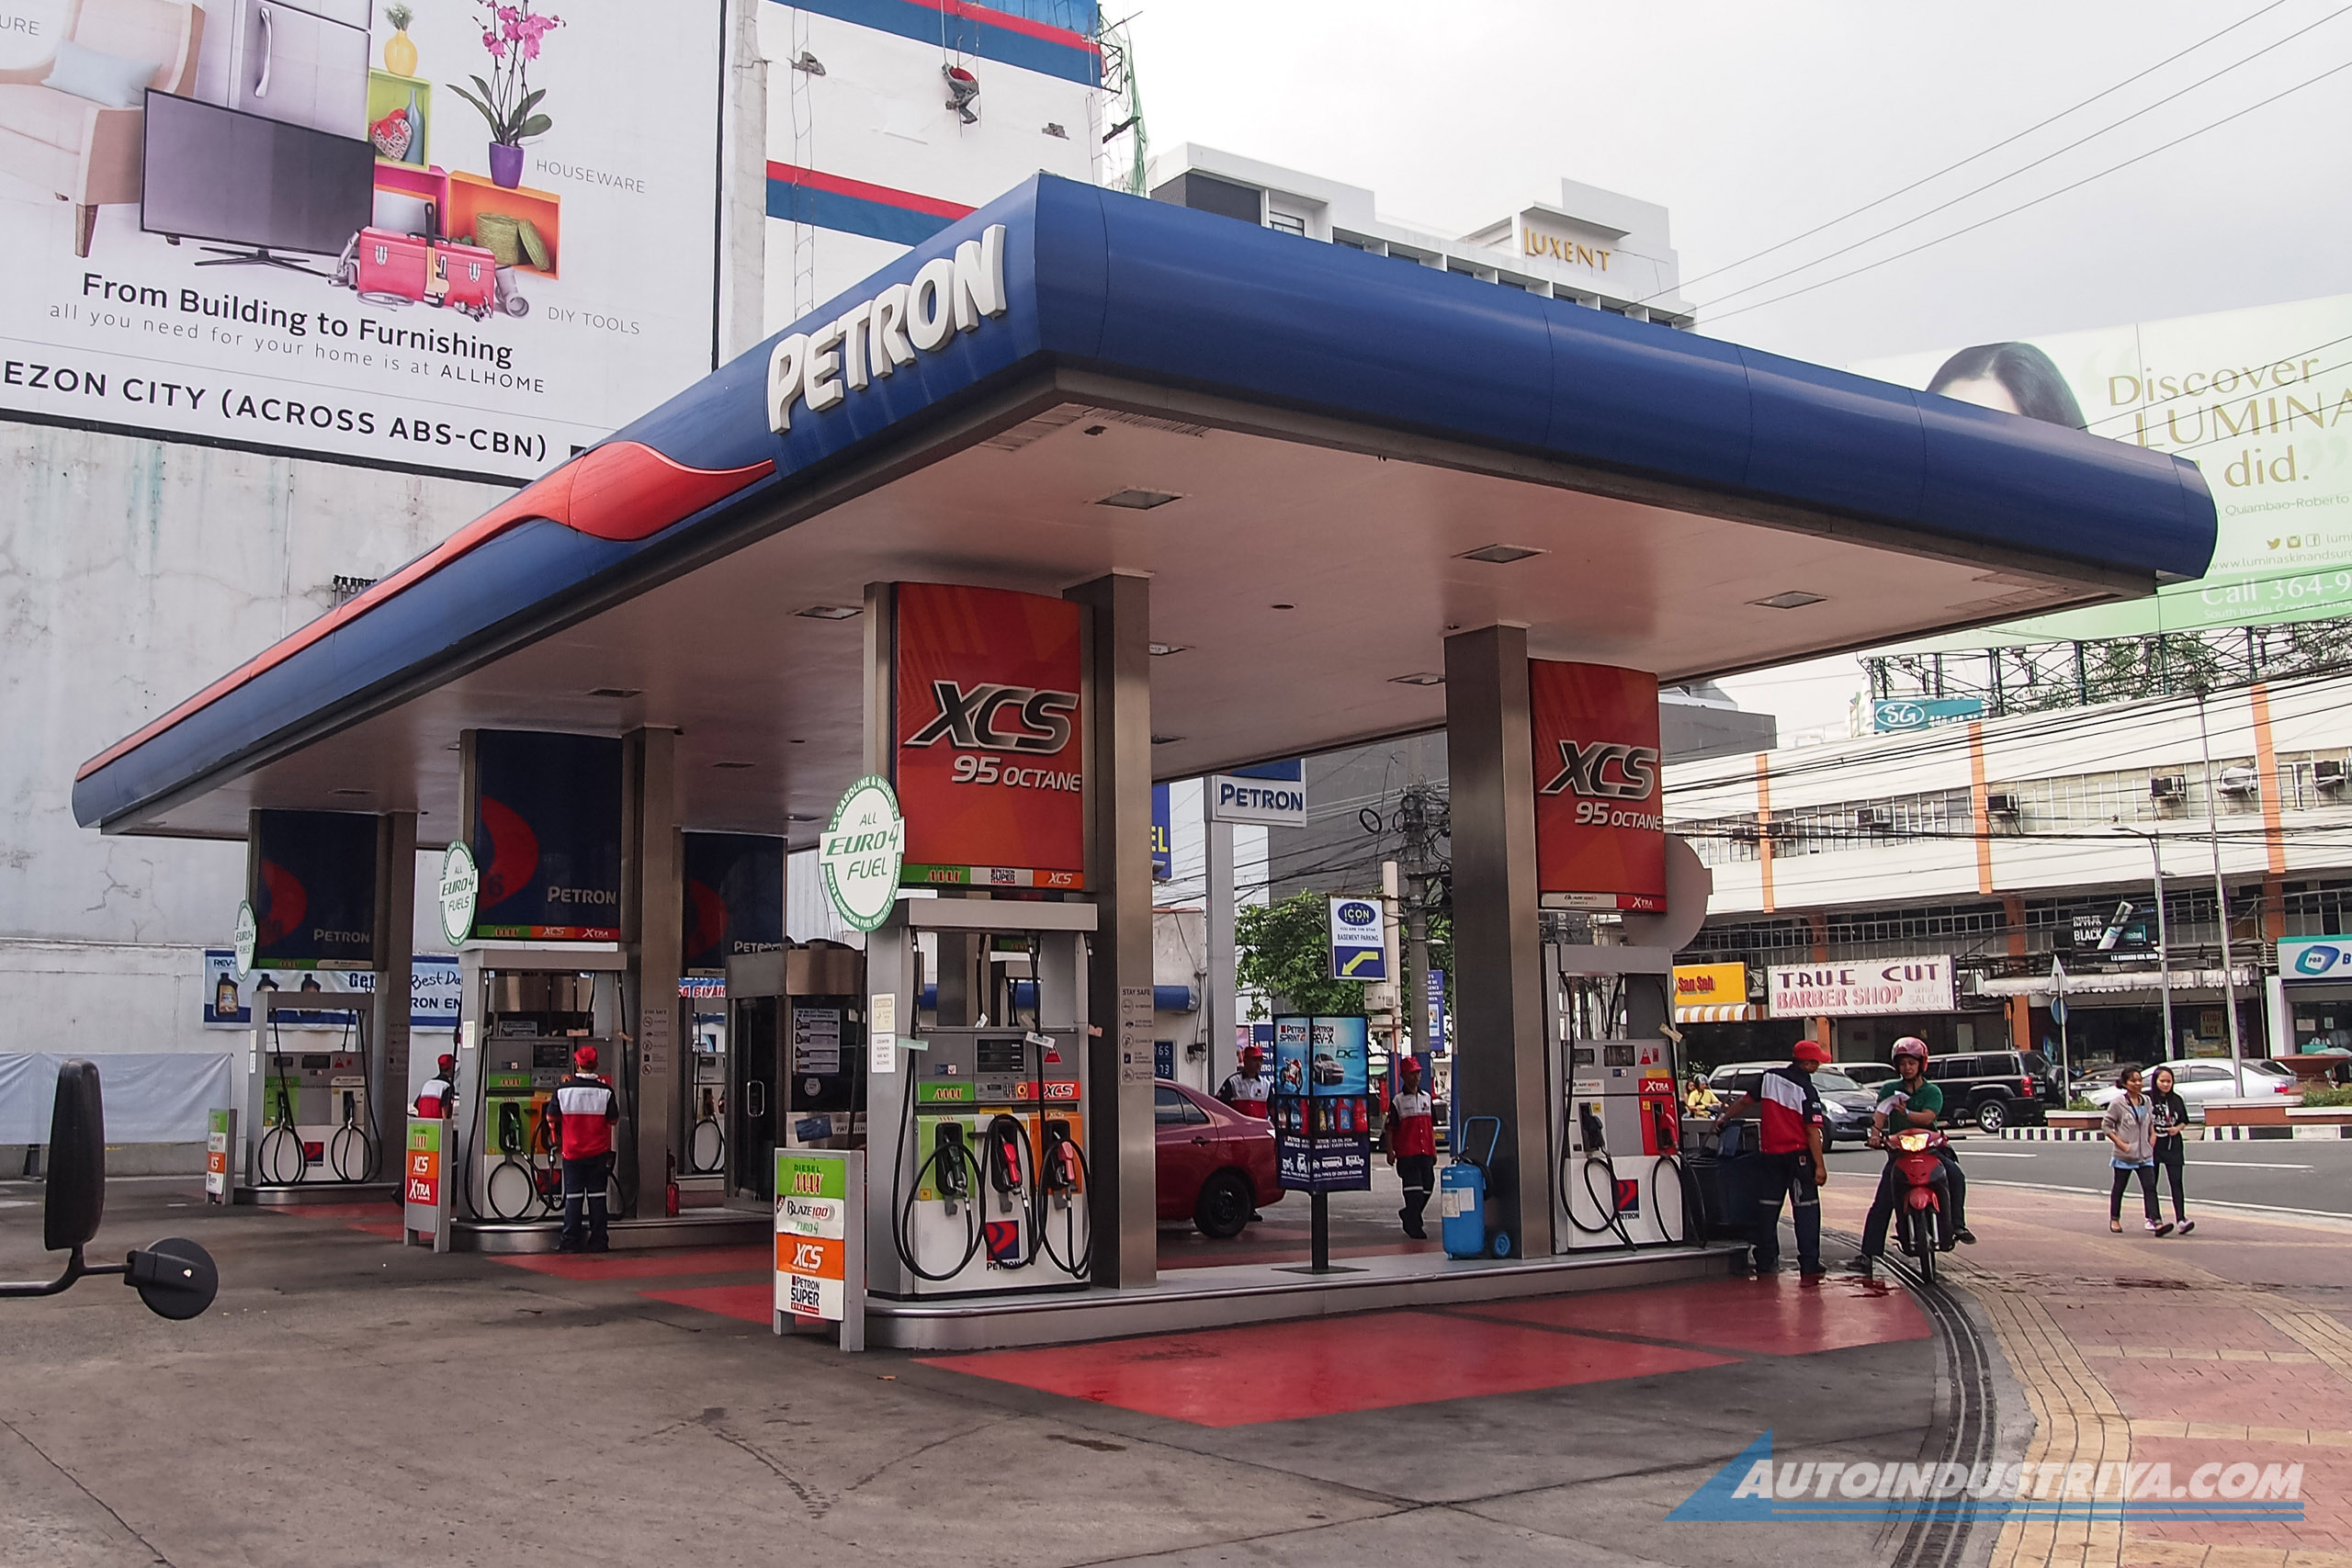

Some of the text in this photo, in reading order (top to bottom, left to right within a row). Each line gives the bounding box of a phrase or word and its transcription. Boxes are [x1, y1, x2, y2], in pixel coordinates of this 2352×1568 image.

[0, 15, 40, 36] URE
[537, 159, 645, 194] HOUSEWARE
[1523, 226, 1611, 271] LUXENT
[83, 272, 514, 370] From Building to Furnishing
[548, 306, 639, 334] DIY TOOLS
[767, 223, 1007, 434] PETRON
[50, 303, 545, 393] all you need for your home is at ALLHOME
[2108, 356, 2320, 406] Discover
[4, 360, 547, 462] EZON CITY (ACROSS ABS-CBN)
[2224, 444, 2310, 488] did.
[2225, 495, 2349, 516] Quiambao-Roberto
[2201, 578, 2257, 605] Call
[902, 680, 1080, 754] XCS
[951, 755, 1081, 793] 95 OCTANE
[1540, 739, 1658, 800] XCS
[836, 776, 870, 816] GASOLINE
[1219, 783, 1304, 811] PETRON
[859, 811, 877, 827] ALL
[1575, 801, 1663, 830] 95 OCTANE
[847, 856, 888, 881] FUEL
[1048, 873, 1073, 885] XCS
[447, 897, 469, 912] FUELS
[548, 886, 616, 905] PETRON
[860, 918, 873, 928] FUEL
[1344, 908, 1369, 919] ICON
[313, 929, 370, 943] PETRON
[543, 927, 565, 937] XCS
[2074, 928, 2102, 942] BLACK
[412, 972, 443, 990] Best
[1777, 964, 1939, 988] TRUE CUT
[1776, 986, 1903, 1010] BARBER SHOP
[1908, 994, 1944, 1005] SALON
[1287, 1024, 1306, 1033] PETRON
[1314, 1033, 1334, 1043] REV-X
[1044, 1083, 1075, 1098] XCS
[413, 1156, 430, 1172] XCS
[794, 1164, 820, 1173] DIESEL
[793, 1242, 824, 1269] XCS
[797, 1275, 820, 1291] PETRON
[791, 1287, 820, 1307] SUPER
